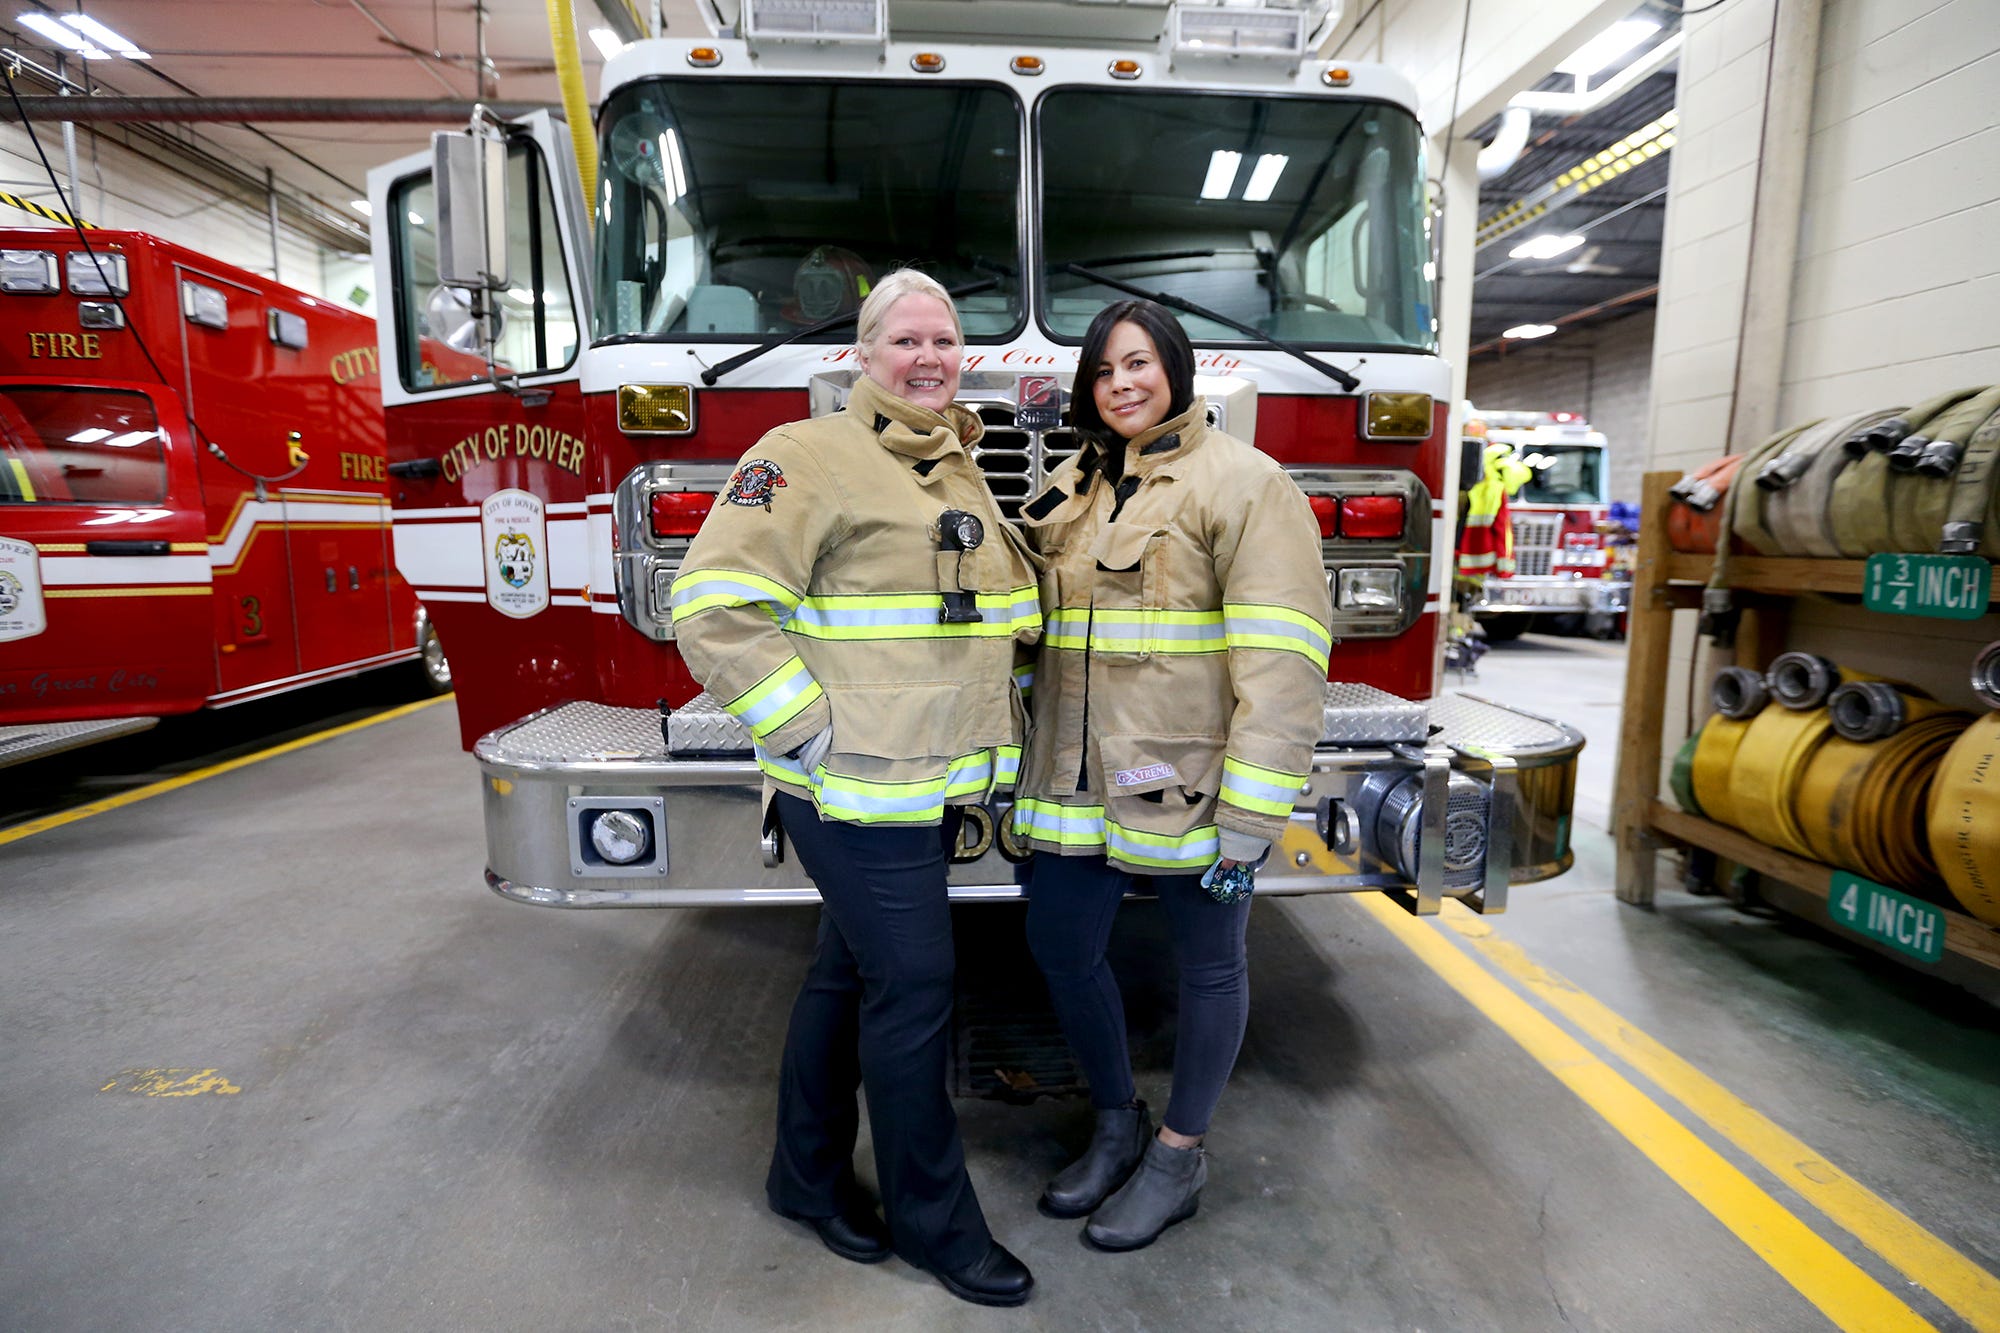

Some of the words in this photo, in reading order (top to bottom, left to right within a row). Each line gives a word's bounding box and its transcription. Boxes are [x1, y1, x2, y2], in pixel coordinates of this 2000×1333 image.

[28, 332, 103, 359] FIRE
[1002, 348, 1056, 364] Our
[330, 346, 379, 385] CITY
[340, 452, 387, 482] FIRE
[441, 433, 481, 484] CITY
[484, 424, 510, 461] OF
[515, 423, 586, 476] DOVER
[485, 501, 501, 516] CITY
[502, 498, 512, 507] OF
[514, 497, 540, 515] DOVER
[0, 542, 33, 557] OVER
[1871, 563, 1883, 602] 1
[1917, 564, 1980, 609] INCH
[242, 596, 262, 636] 3
[31, 672, 98, 698] Great
[1839, 883, 1859, 921] 4
[1867, 891, 1936, 954] INCH
